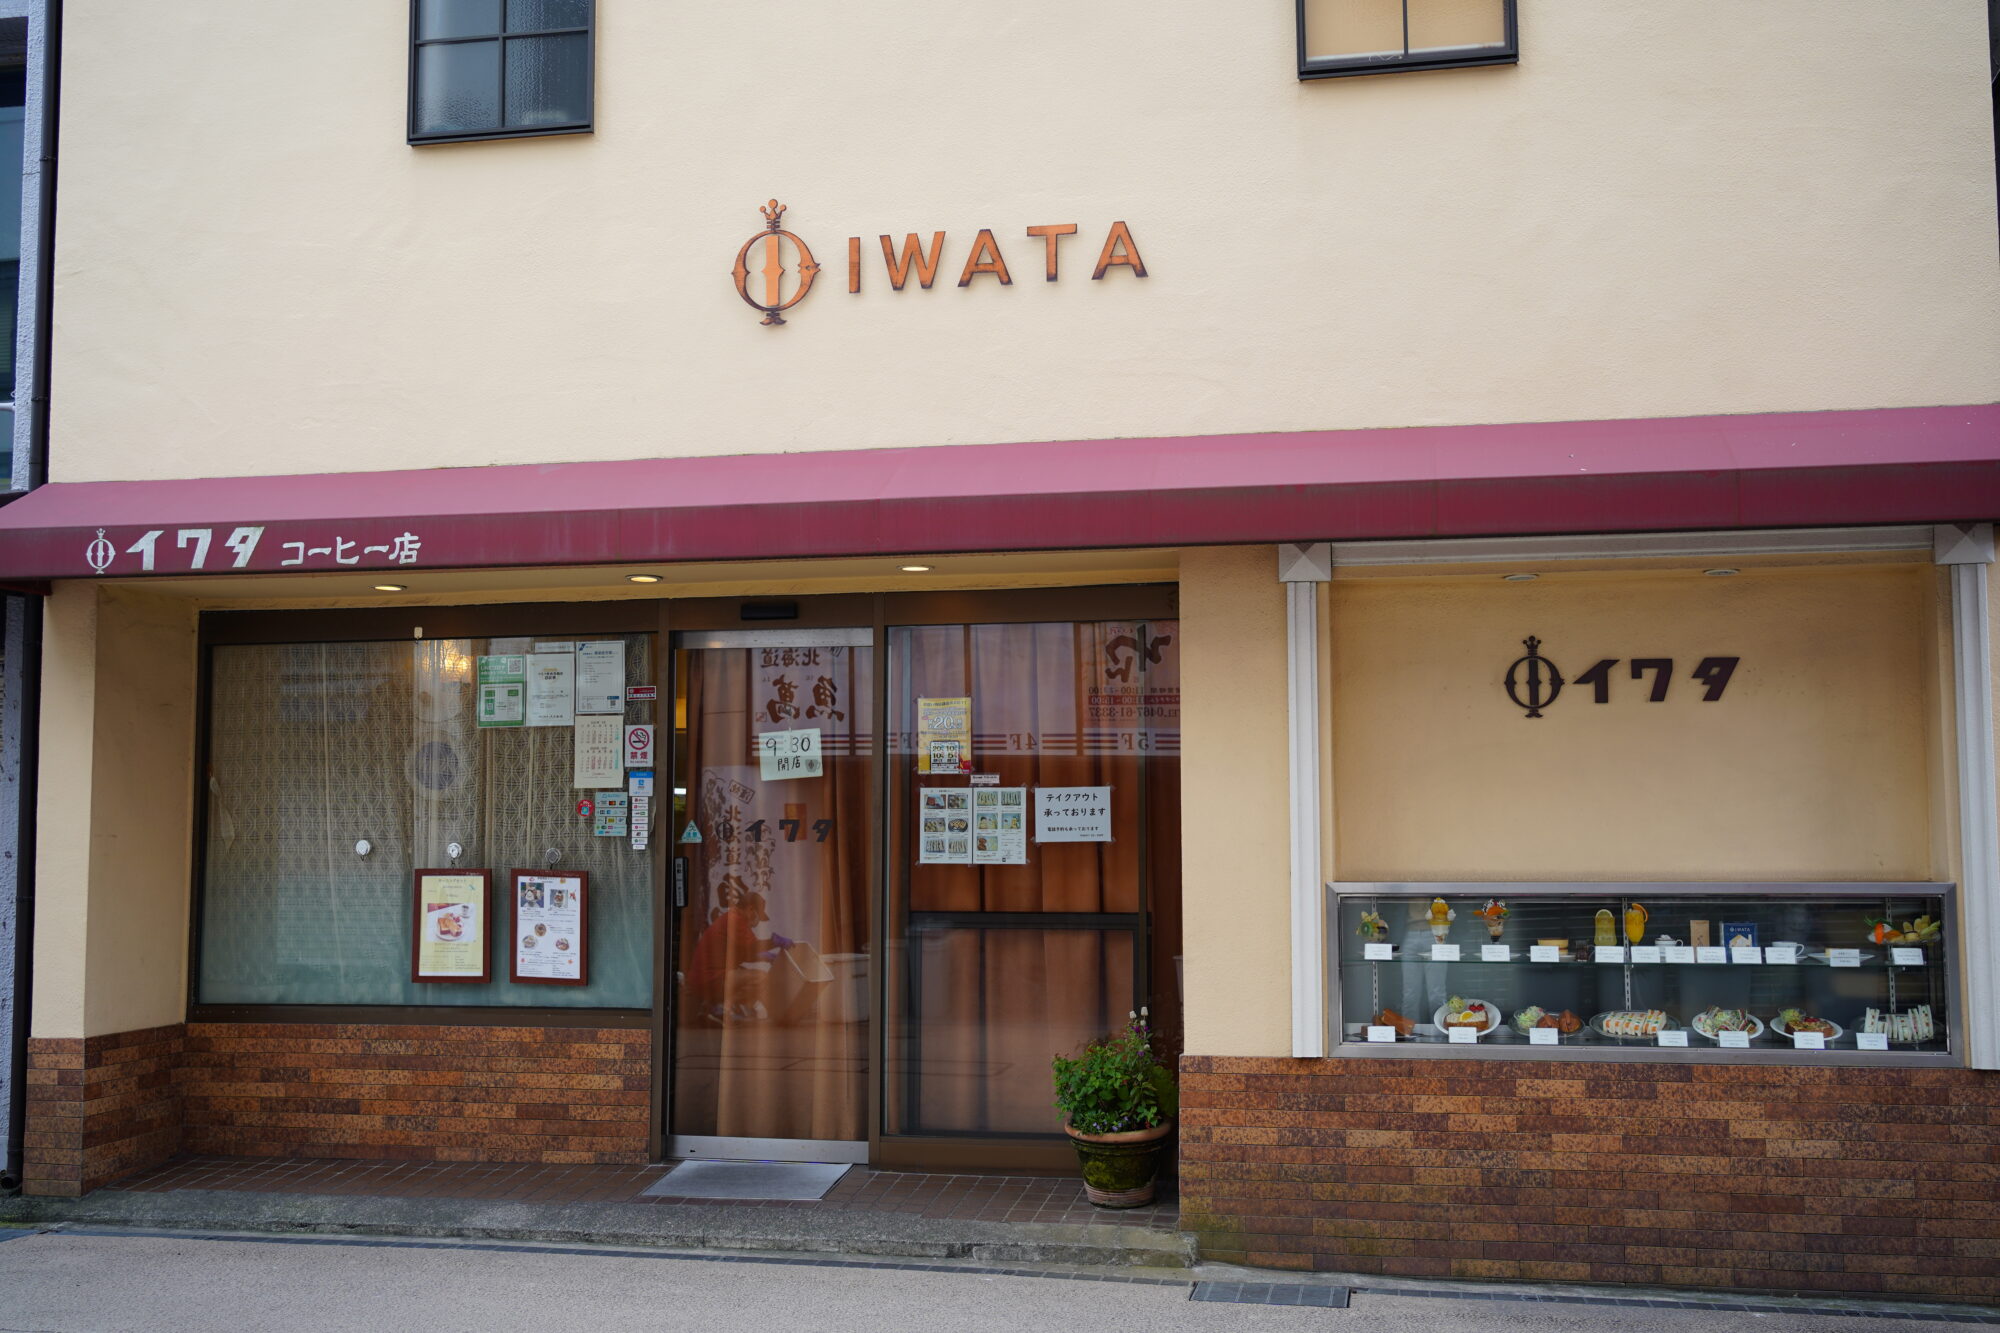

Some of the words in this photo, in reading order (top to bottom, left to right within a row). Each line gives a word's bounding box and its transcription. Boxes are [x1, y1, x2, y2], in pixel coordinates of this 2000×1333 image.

[848, 220, 1148, 294] IWATA
[126, 526, 265, 571] イワタ
[281, 531, 421, 567] コーヒー店
[1573, 657, 1740, 704] イワタ
[630, 751, 648, 759] 禁煙
[777, 755, 801, 772] 開店
[1046, 793, 1098, 802] テイクアウト
[1044, 807, 1106, 817] 承っております
[745, 820, 833, 842] イワタ
